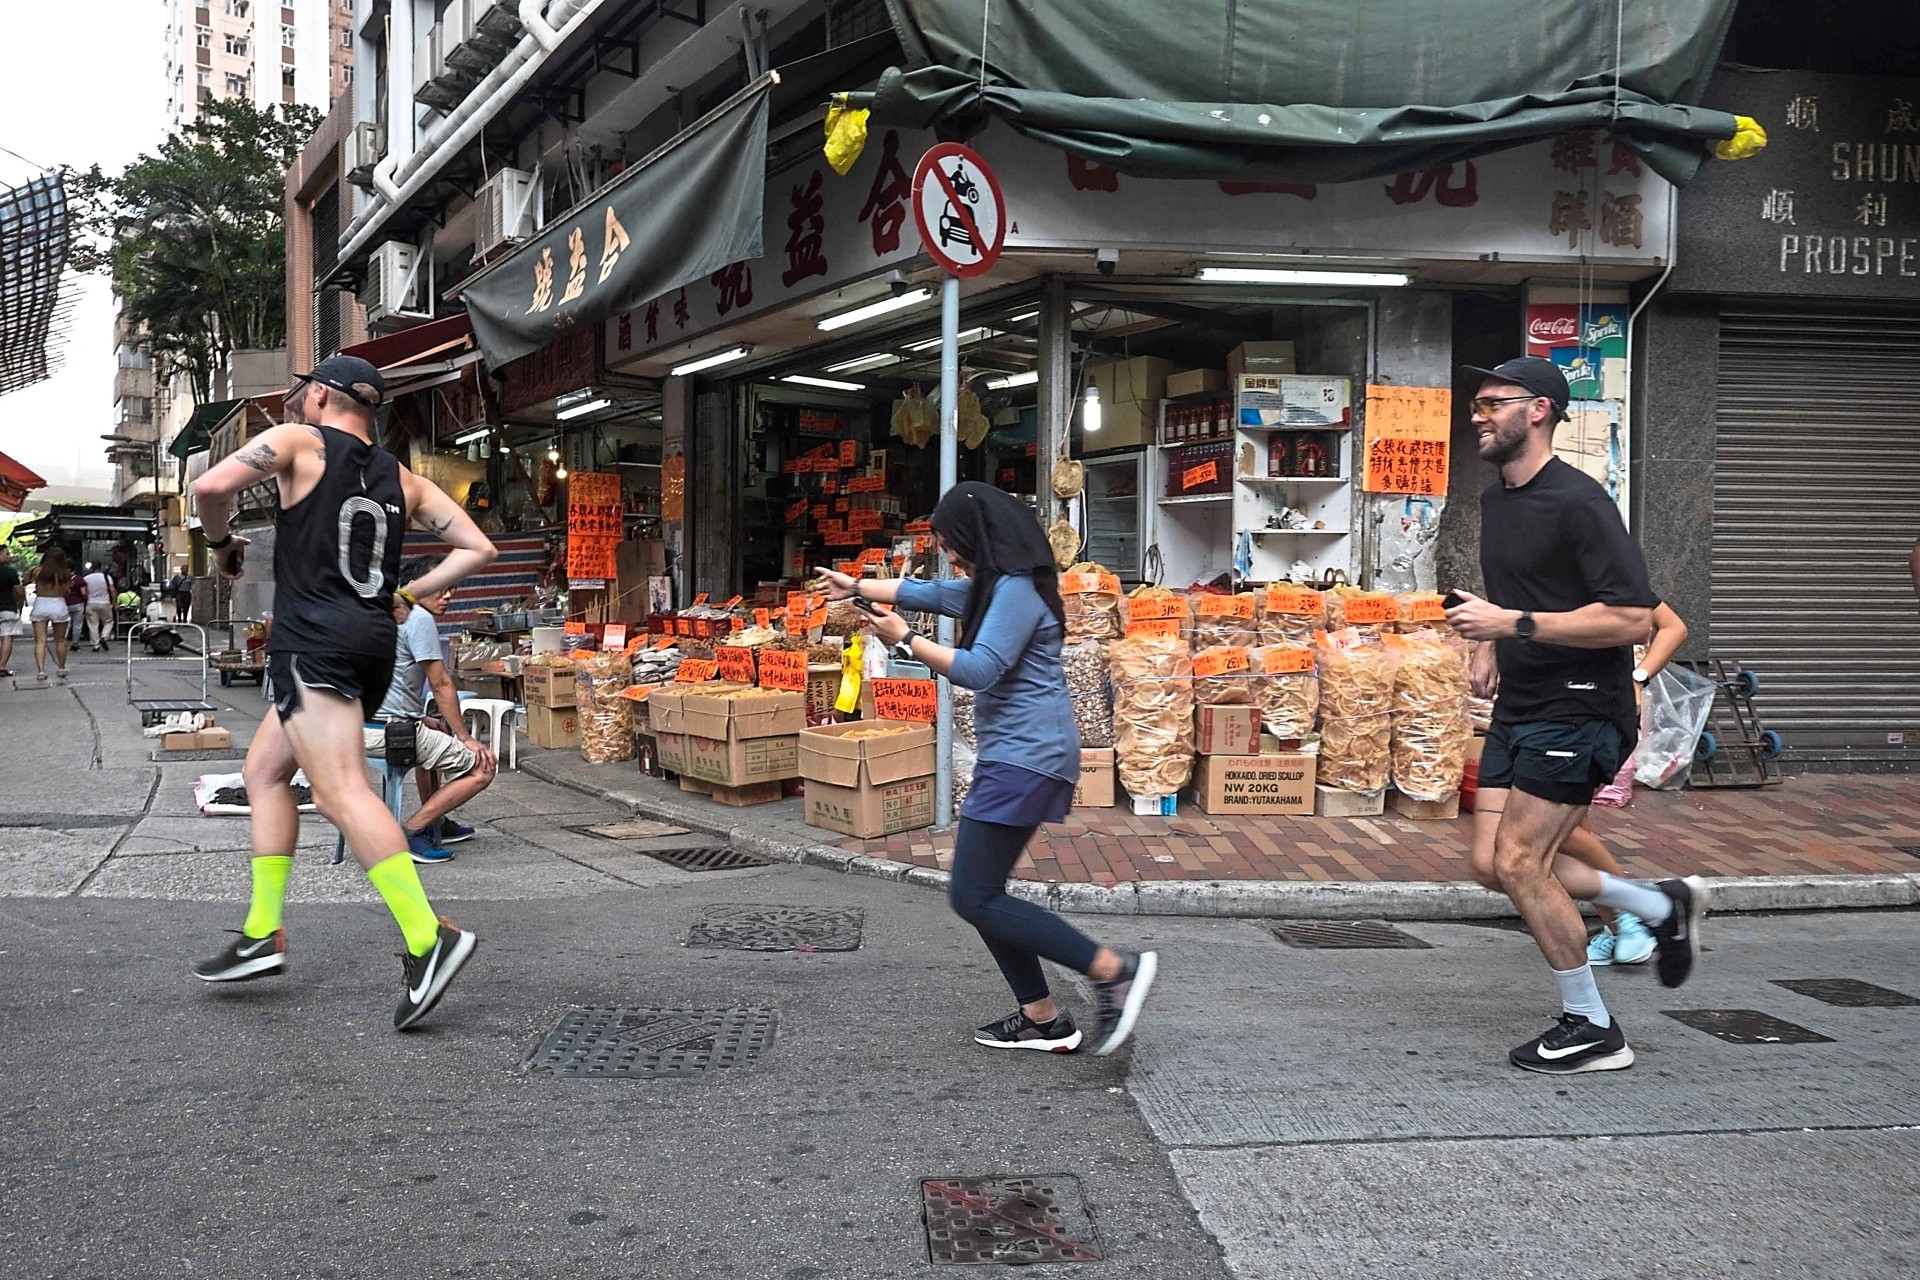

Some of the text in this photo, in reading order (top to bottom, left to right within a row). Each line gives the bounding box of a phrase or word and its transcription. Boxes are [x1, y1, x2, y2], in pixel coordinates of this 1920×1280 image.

[1780, 234, 1918, 277] PROSPE
[1587, 319, 1620, 343] Sprite
[816, 681, 824, 697] NW
[1259, 771, 1277, 780] DRIED
[1278, 771, 1305, 781] SCALLOP
[1224, 784, 1279, 793] NW 20KG
